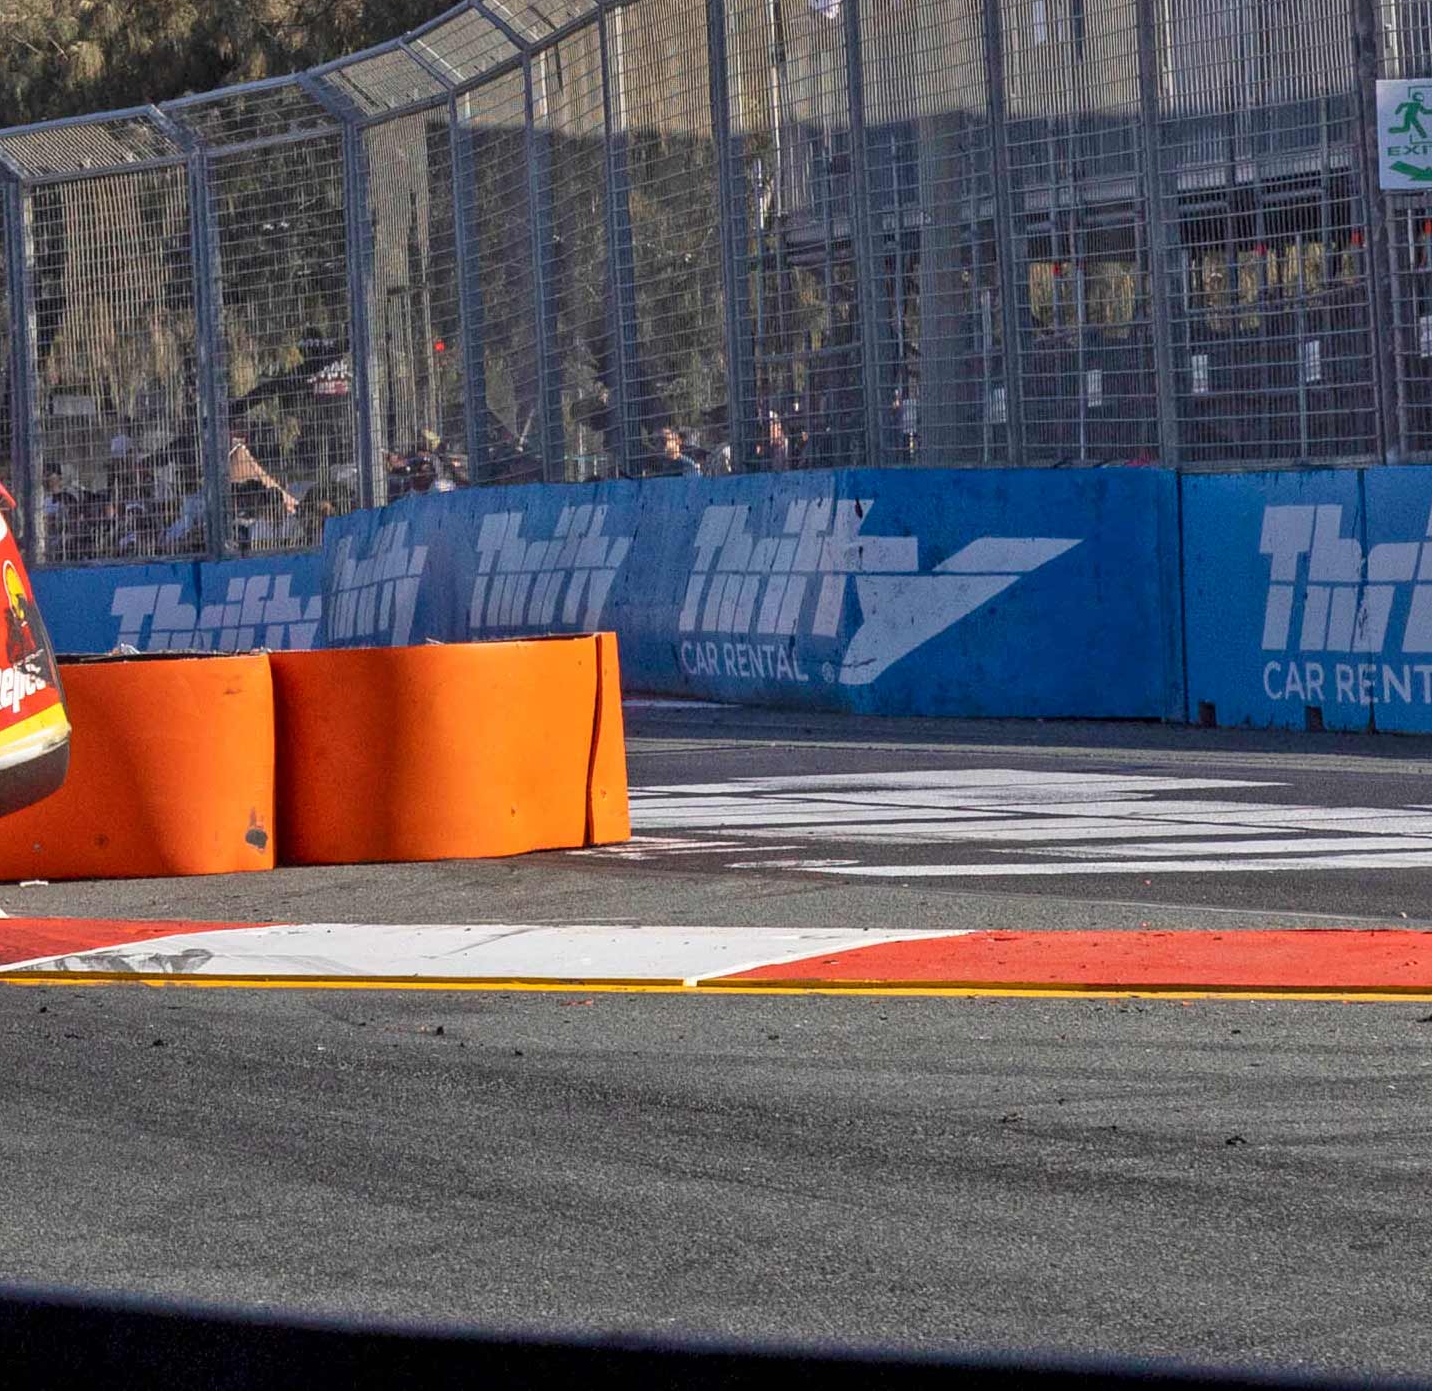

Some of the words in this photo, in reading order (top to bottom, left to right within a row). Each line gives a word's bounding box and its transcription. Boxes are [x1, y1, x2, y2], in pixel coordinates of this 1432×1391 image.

[470, 504, 633, 631] Thrifty
[679, 499, 1084, 685] Thrifty
[681, 639, 718, 676] CAR
[723, 641, 809, 682] RENTAL
[1263, 660, 1325, 701] CAR
